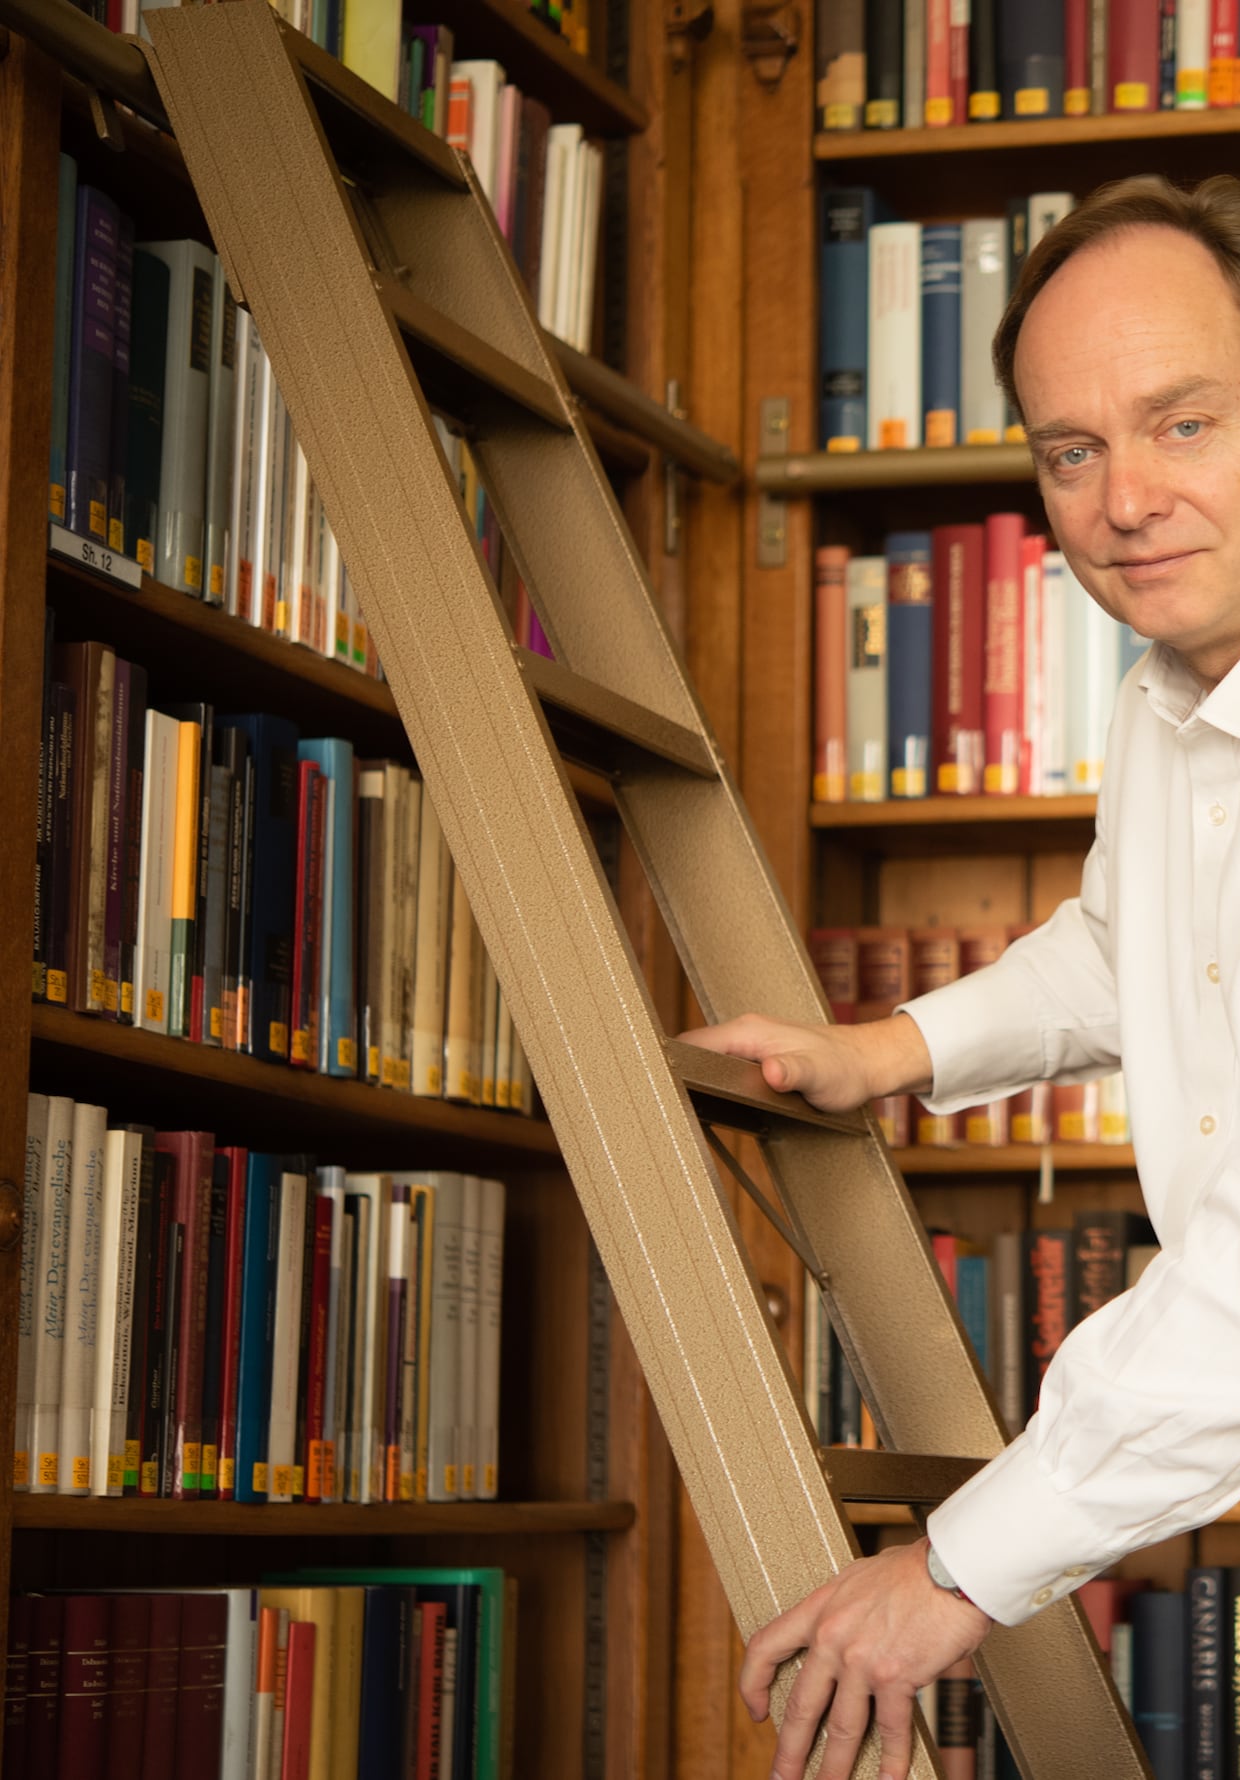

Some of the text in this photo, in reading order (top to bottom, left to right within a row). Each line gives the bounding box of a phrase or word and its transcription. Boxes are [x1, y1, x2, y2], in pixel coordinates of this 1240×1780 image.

[82, 543, 112, 572] Sh. 12
[112, 815, 121, 843] und
[110, 847, 119, 891] Kirche
[128, 1157, 139, 1233] Martyrium
[45, 1139, 66, 1341] Meier Der evangelische
[77, 1150, 97, 1349] Meier Der evangelische
[123, 1238, 135, 1321] Widerstand,
[1191, 1575, 1218, 1691] CANARIS
[432, 1676, 441, 1718] KARL
